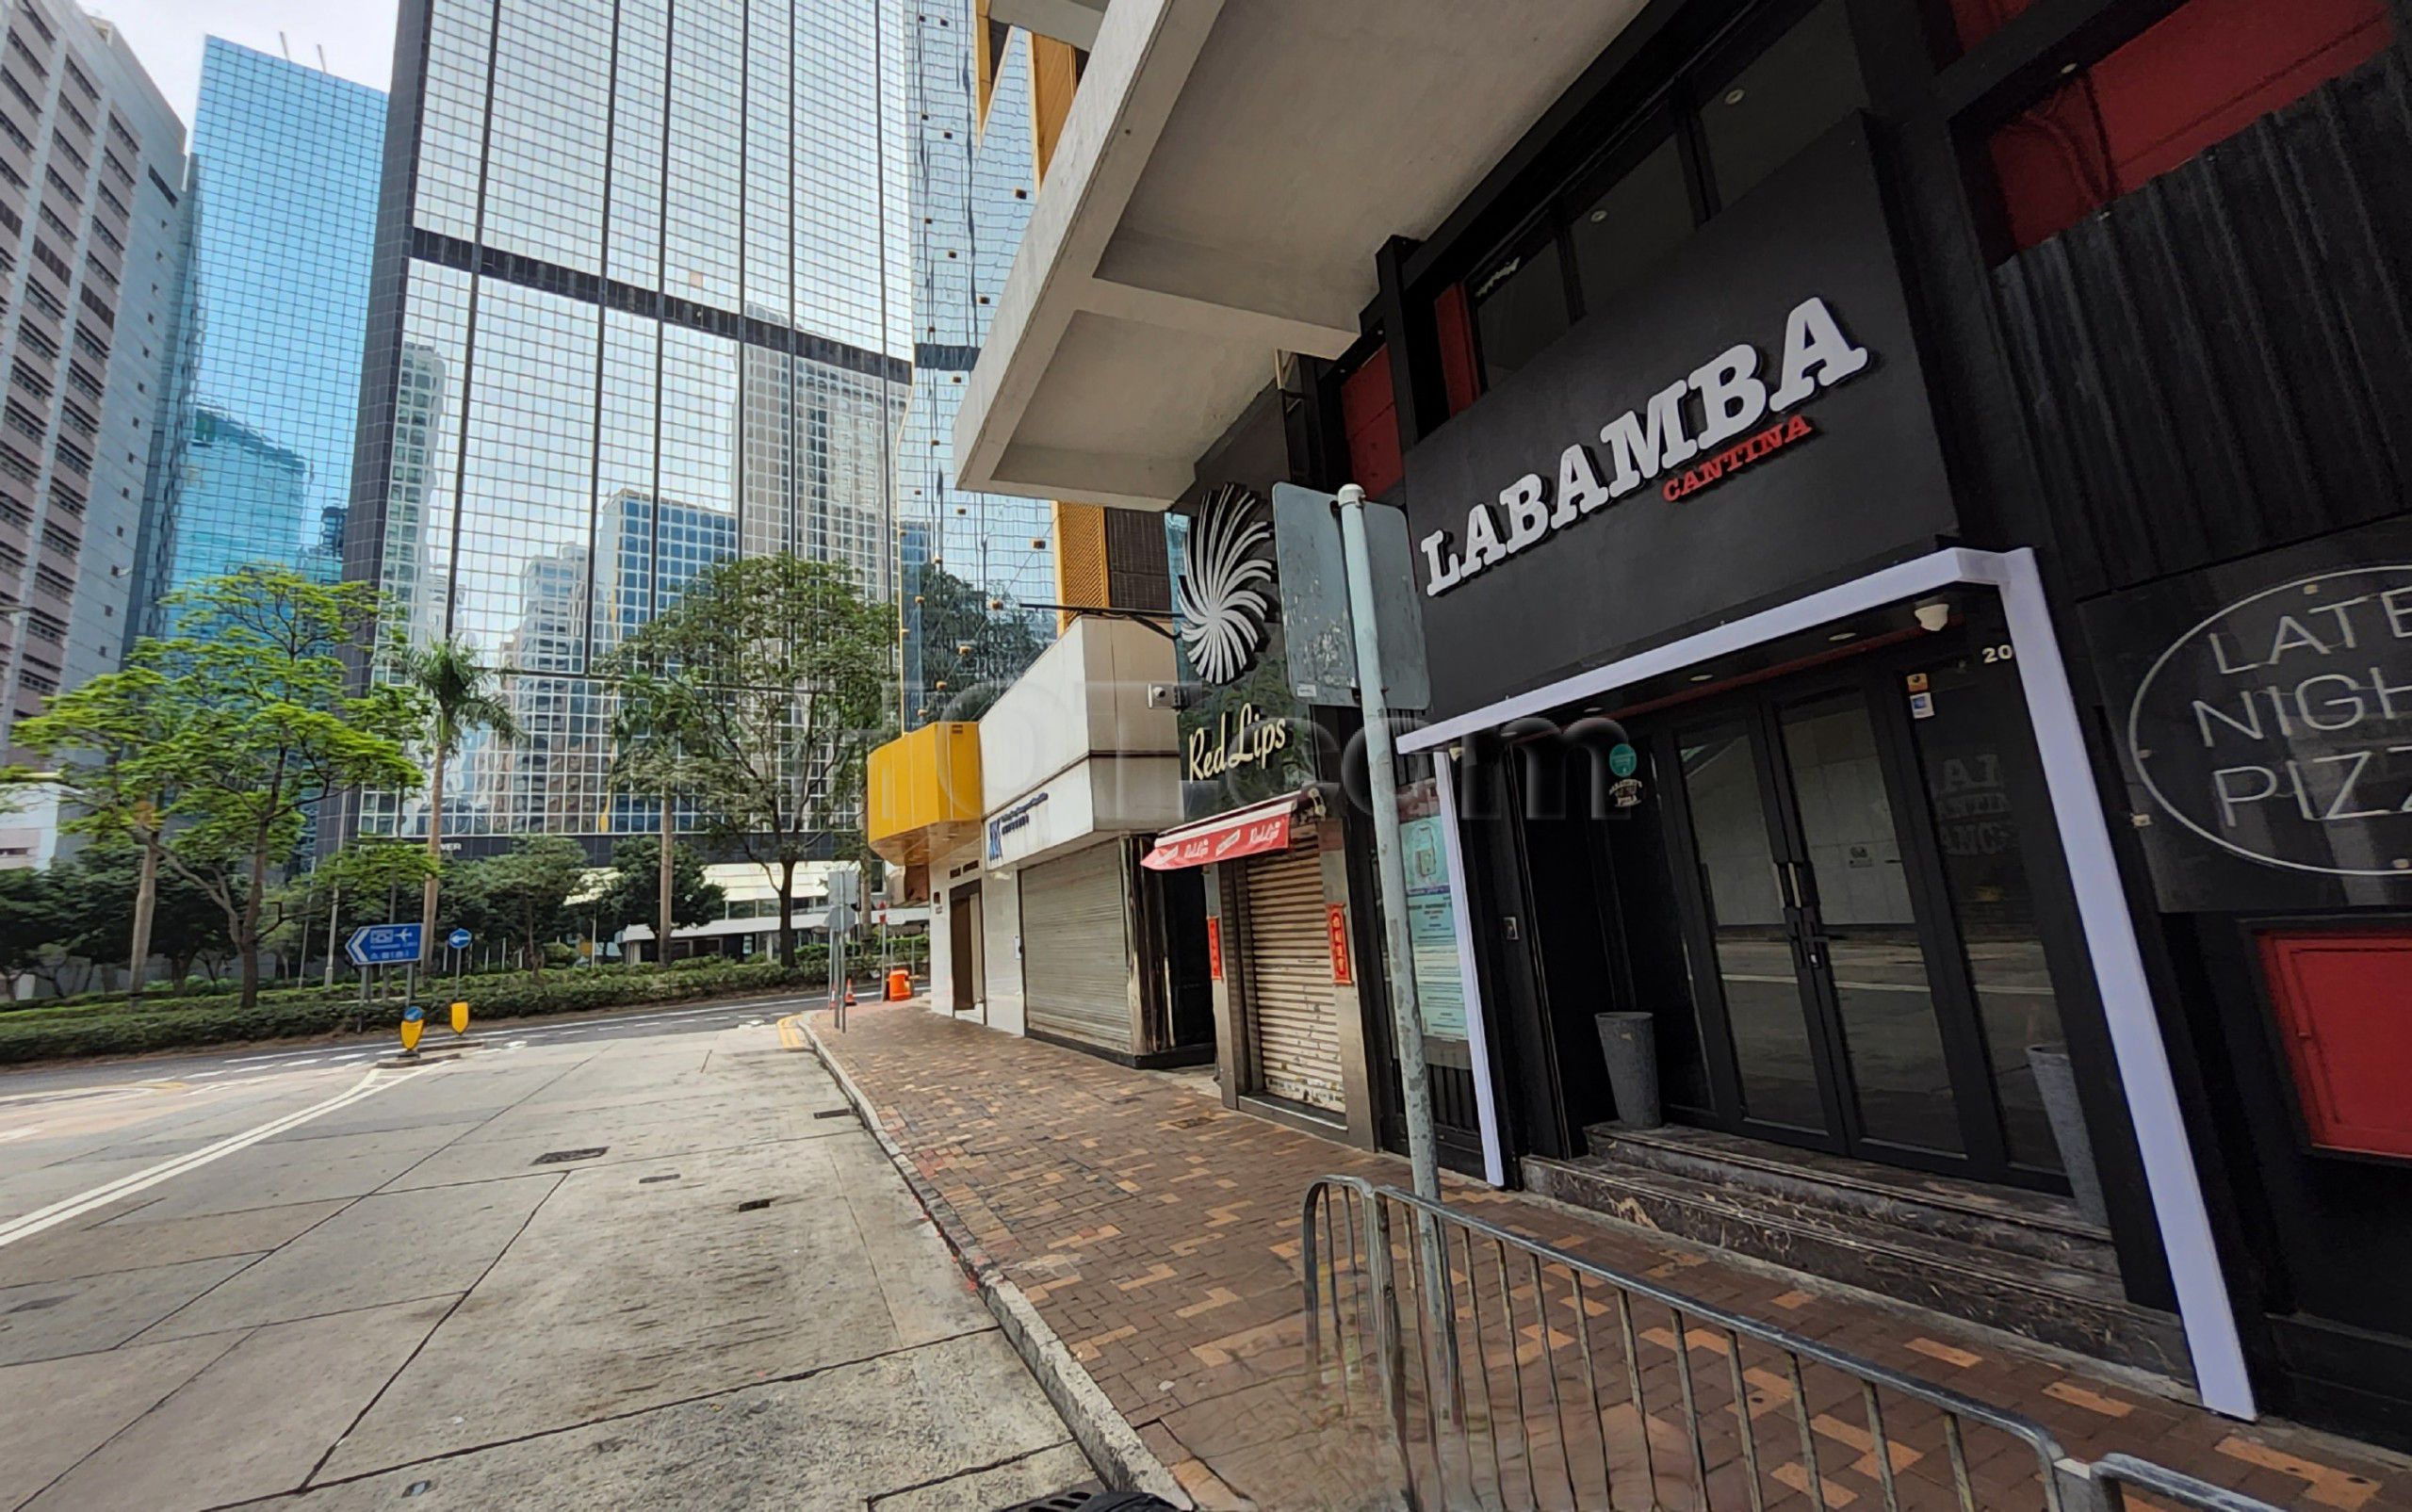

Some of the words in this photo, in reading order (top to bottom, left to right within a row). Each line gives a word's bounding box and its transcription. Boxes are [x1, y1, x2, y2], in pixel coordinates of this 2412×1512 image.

[1662, 414, 1811, 502] CANTINA
[1981, 644, 2013, 664] 20
[2208, 587, 2412, 675] LATE
[1189, 711, 1228, 784] Red
[1228, 702, 1287, 770] Lips
